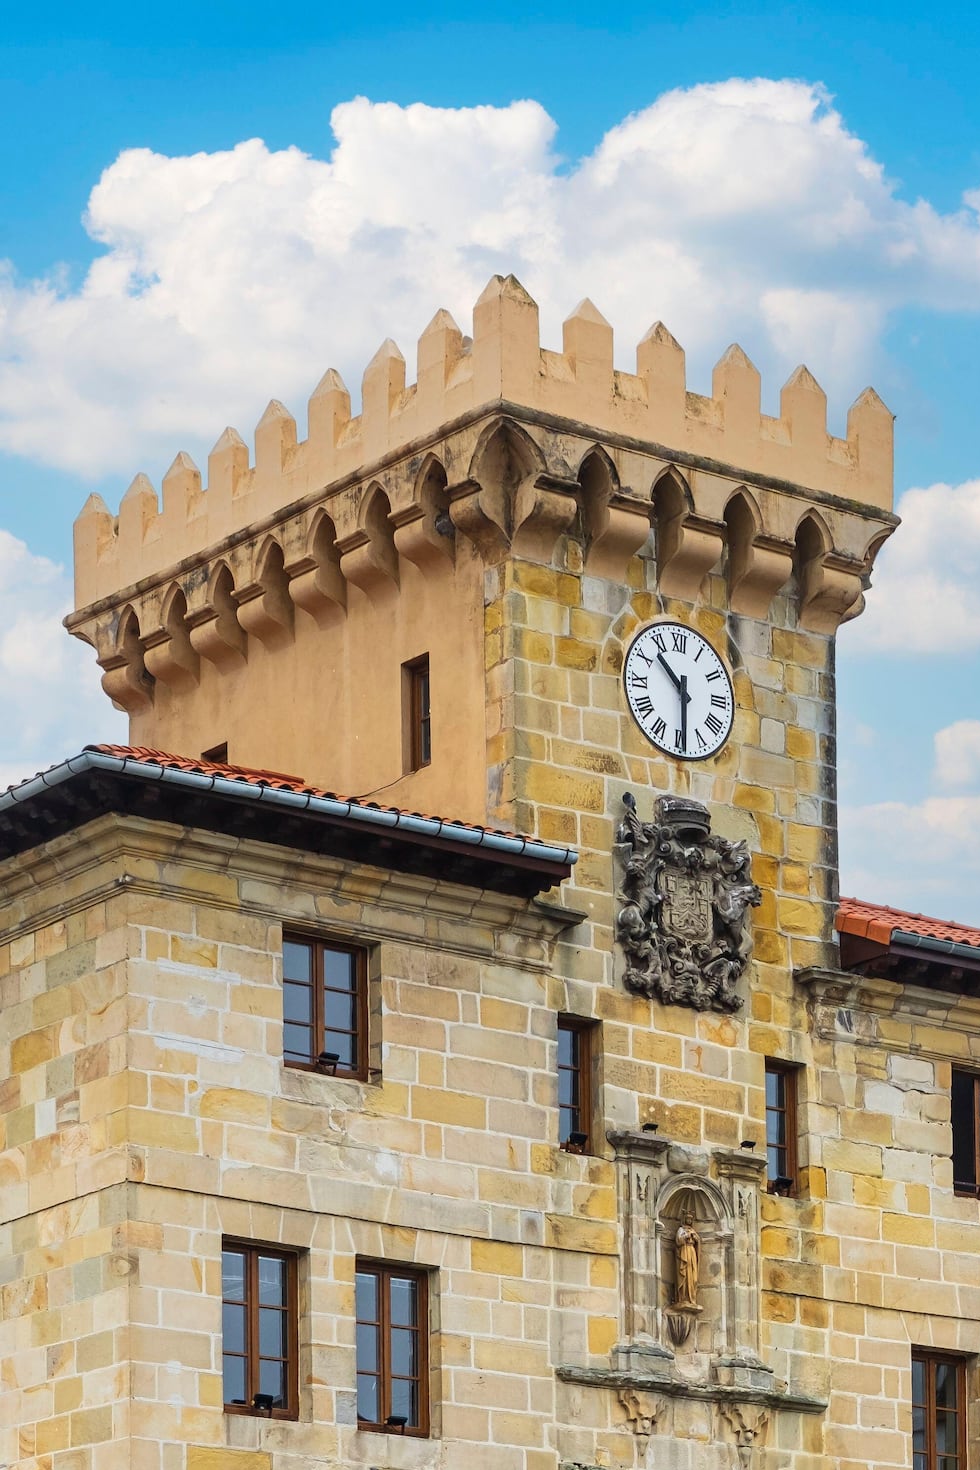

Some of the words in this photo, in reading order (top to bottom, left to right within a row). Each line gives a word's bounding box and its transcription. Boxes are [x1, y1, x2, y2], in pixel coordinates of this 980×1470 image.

[651, 633, 668, 653] XI
[672, 632, 688, 654] XII
[636, 648, 653, 668] X
[632, 671, 647, 689] IX
[705, 669, 721, 683] II
[635, 696, 655, 719] VIII
[711, 694, 726, 711] III
[650, 717, 667, 740] VII
[694, 728, 707, 748] V
